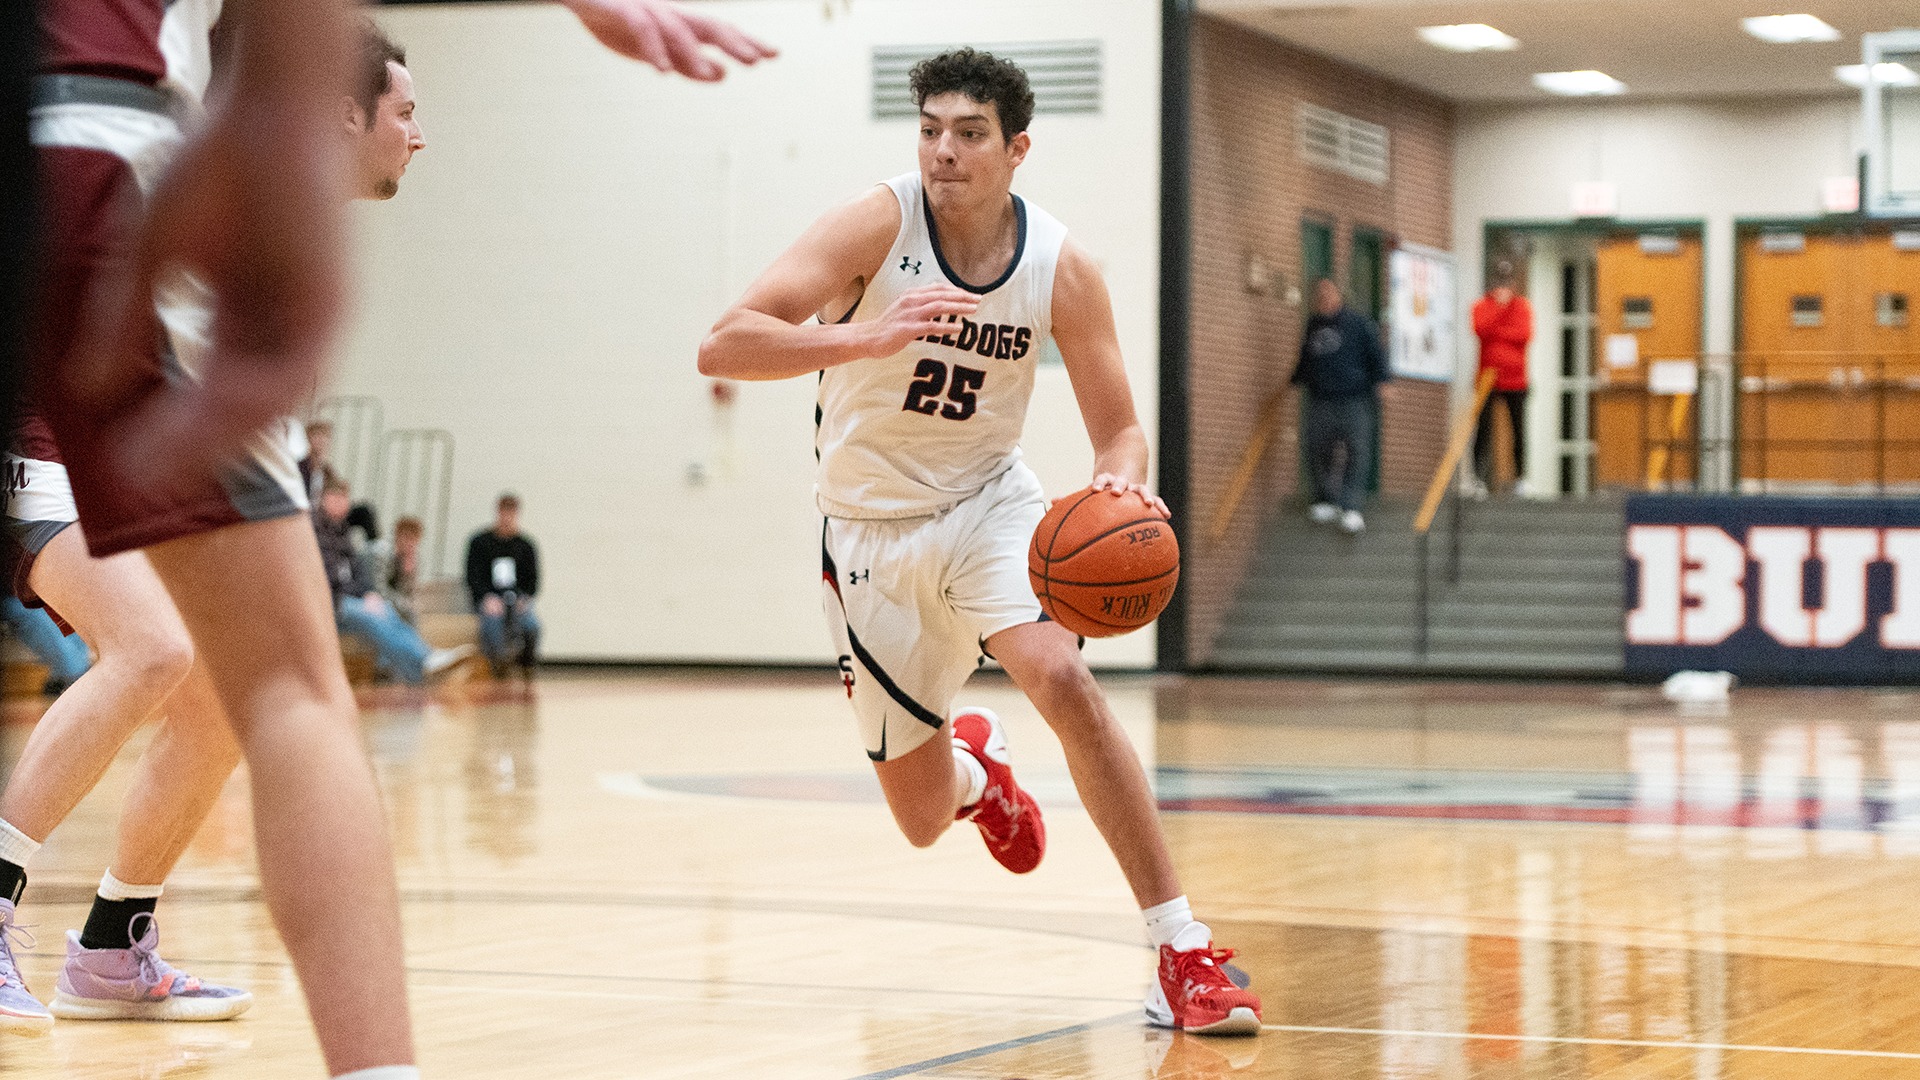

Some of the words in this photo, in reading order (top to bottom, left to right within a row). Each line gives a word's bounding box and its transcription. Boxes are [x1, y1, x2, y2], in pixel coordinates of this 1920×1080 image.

[902, 358, 986, 421] 25
[1126, 525, 1160, 545] ROCK
[1102, 593, 1151, 620] ROCK
